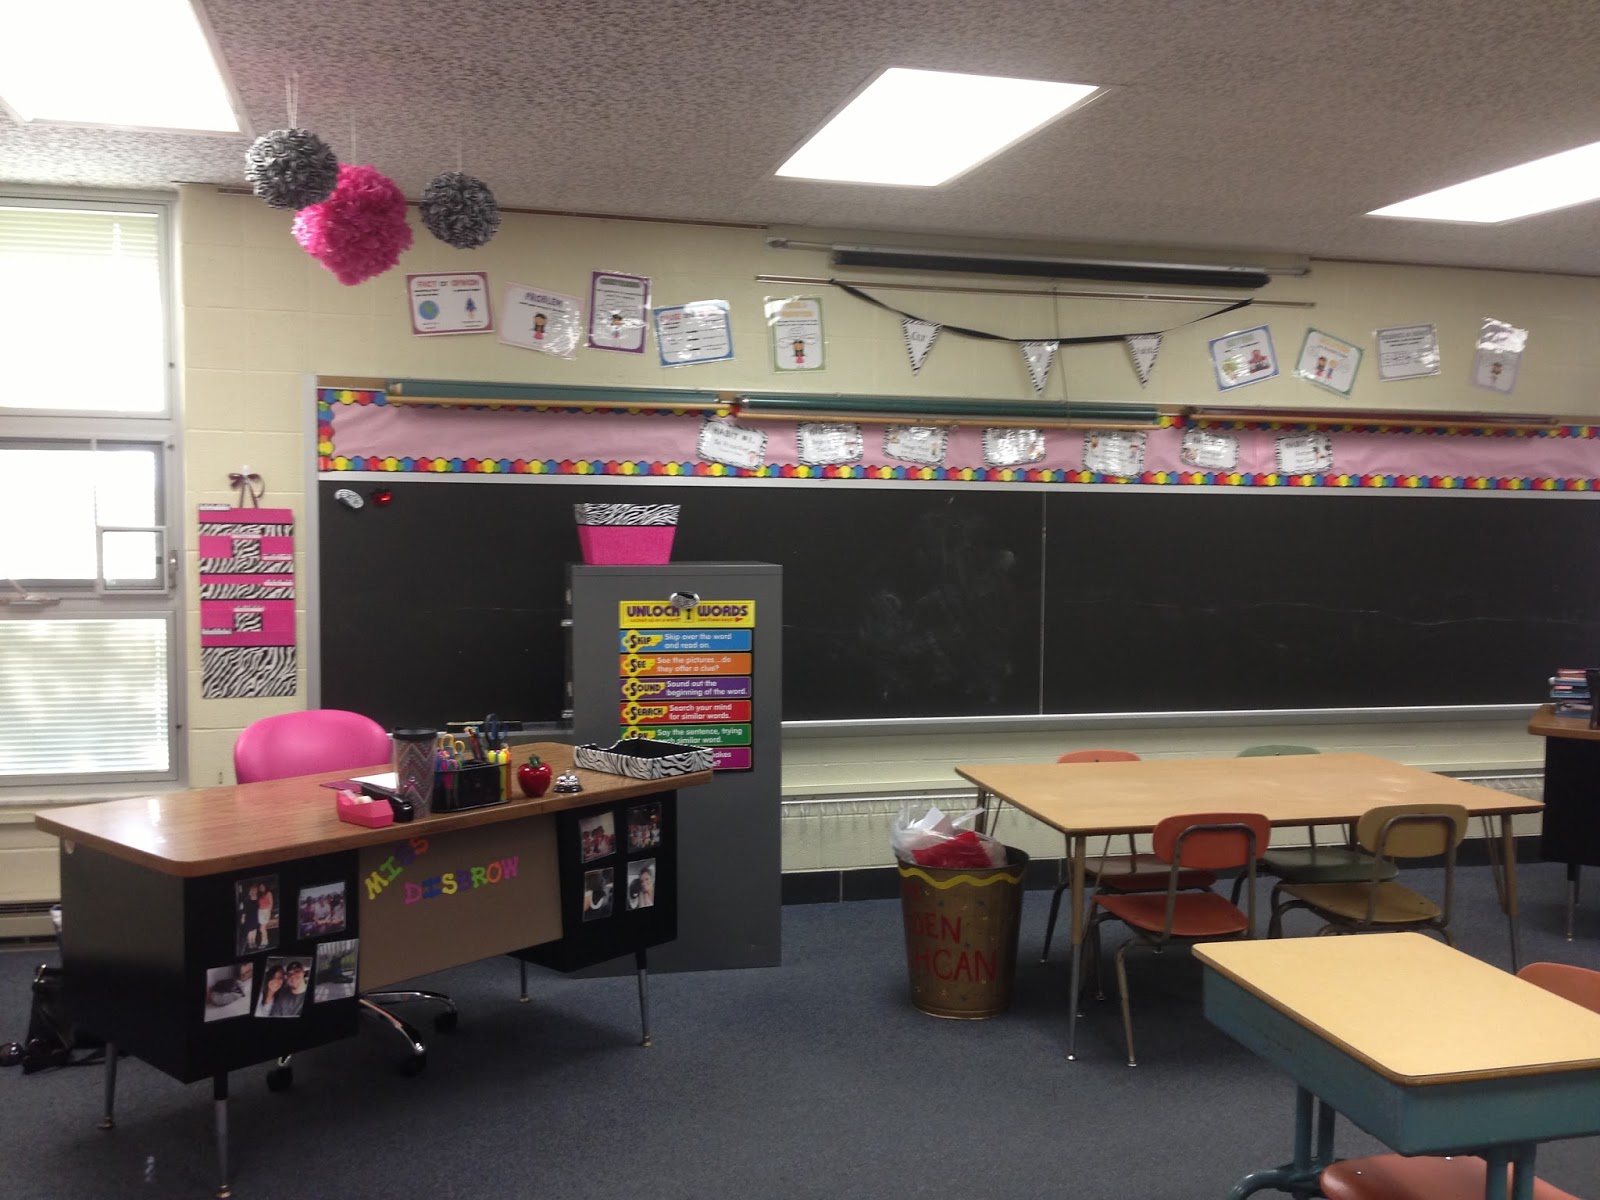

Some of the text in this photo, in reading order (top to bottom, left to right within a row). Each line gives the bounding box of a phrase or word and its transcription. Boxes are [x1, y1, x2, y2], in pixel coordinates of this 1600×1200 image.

[698, 605, 749, 617] WORDS
[630, 635, 652, 649] SKIP
[664, 633, 680, 642] Skip
[657, 656, 671, 664] See
[672, 656, 685, 664] the
[630, 658, 647, 673] SEE
[657, 665, 673, 674] they
[666, 680, 690, 688] Sound
[630, 682, 661, 697] SOUND
[666, 688, 703, 698] beginning
[669, 703, 694, 712] Search
[713, 703, 733, 711] mind
[630, 706, 664, 721] SEARCH
[669, 711, 732, 720] for similar words.
[657, 727, 743, 736] Say the sentence, trying
[404, 856, 520, 905] DISBROW
